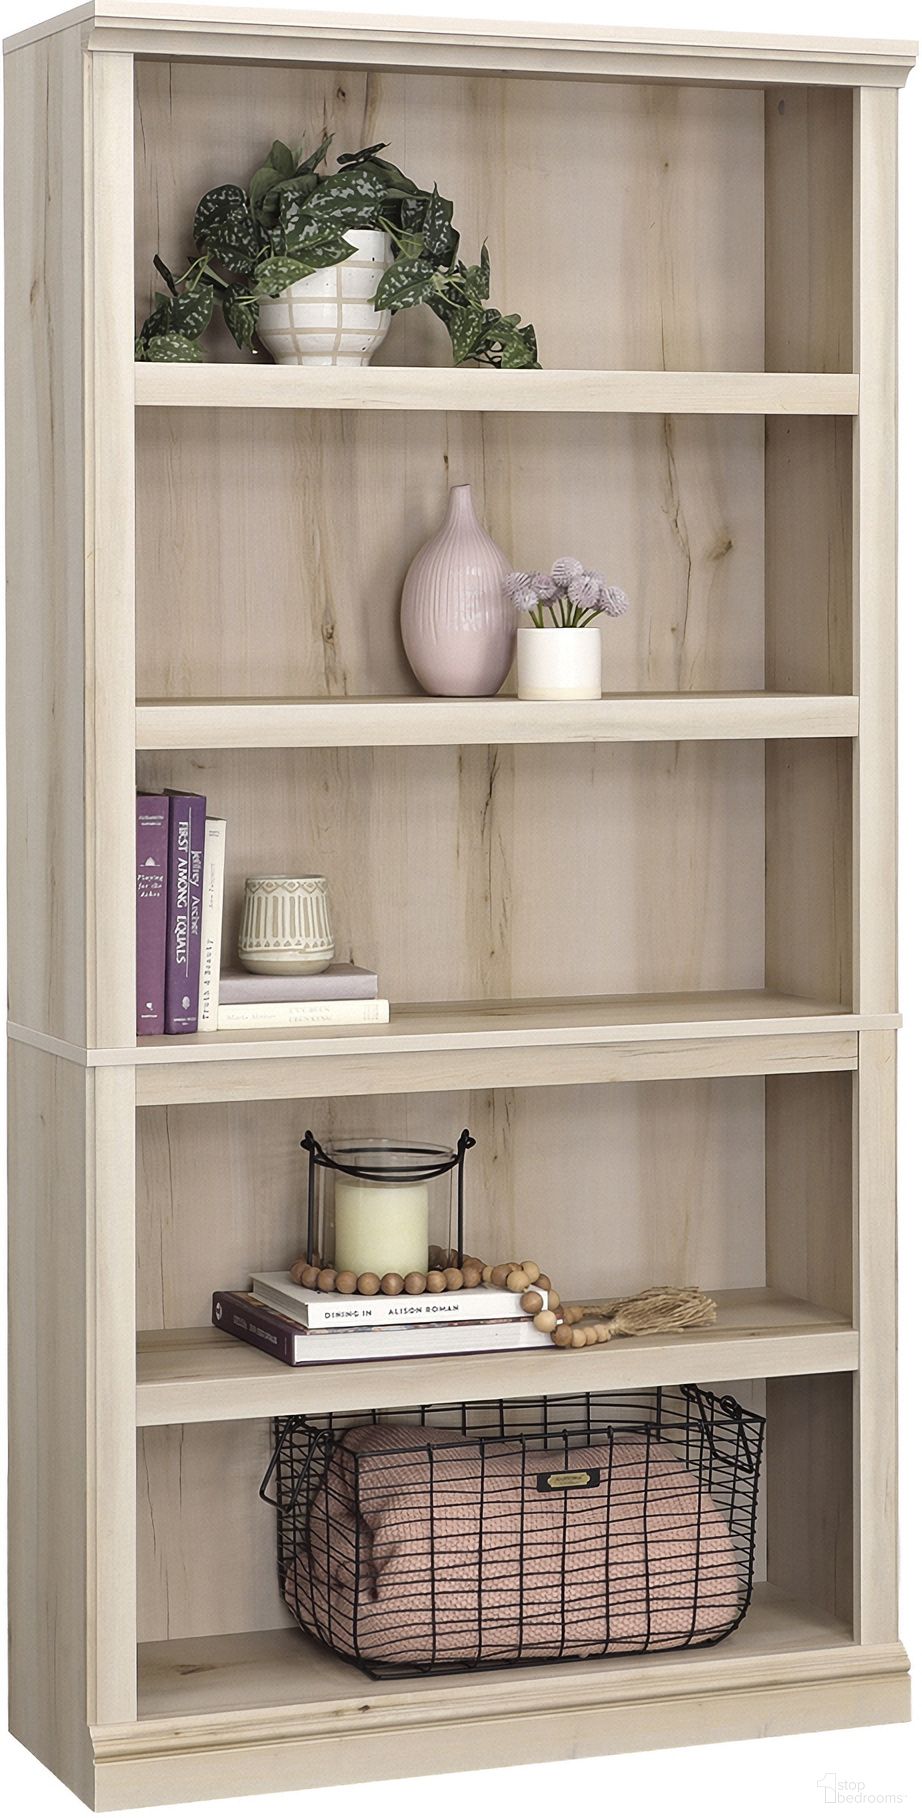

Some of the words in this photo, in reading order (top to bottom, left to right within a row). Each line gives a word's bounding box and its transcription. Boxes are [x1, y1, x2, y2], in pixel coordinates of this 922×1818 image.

[178, 822, 188, 852] FIRST
[177, 857, 187, 908] AMONG
[191, 896, 200, 935] Archer
[175, 915, 187, 964] EQUALS
[204, 939, 214, 975] Beauty
[202, 990, 211, 1020] Truth
[324, 1310, 360, 1319] DINING
[362, 1309, 373, 1317] IN
[388, 1306, 422, 1316] ALISON
[425, 1304, 460, 1314] ROMAN
